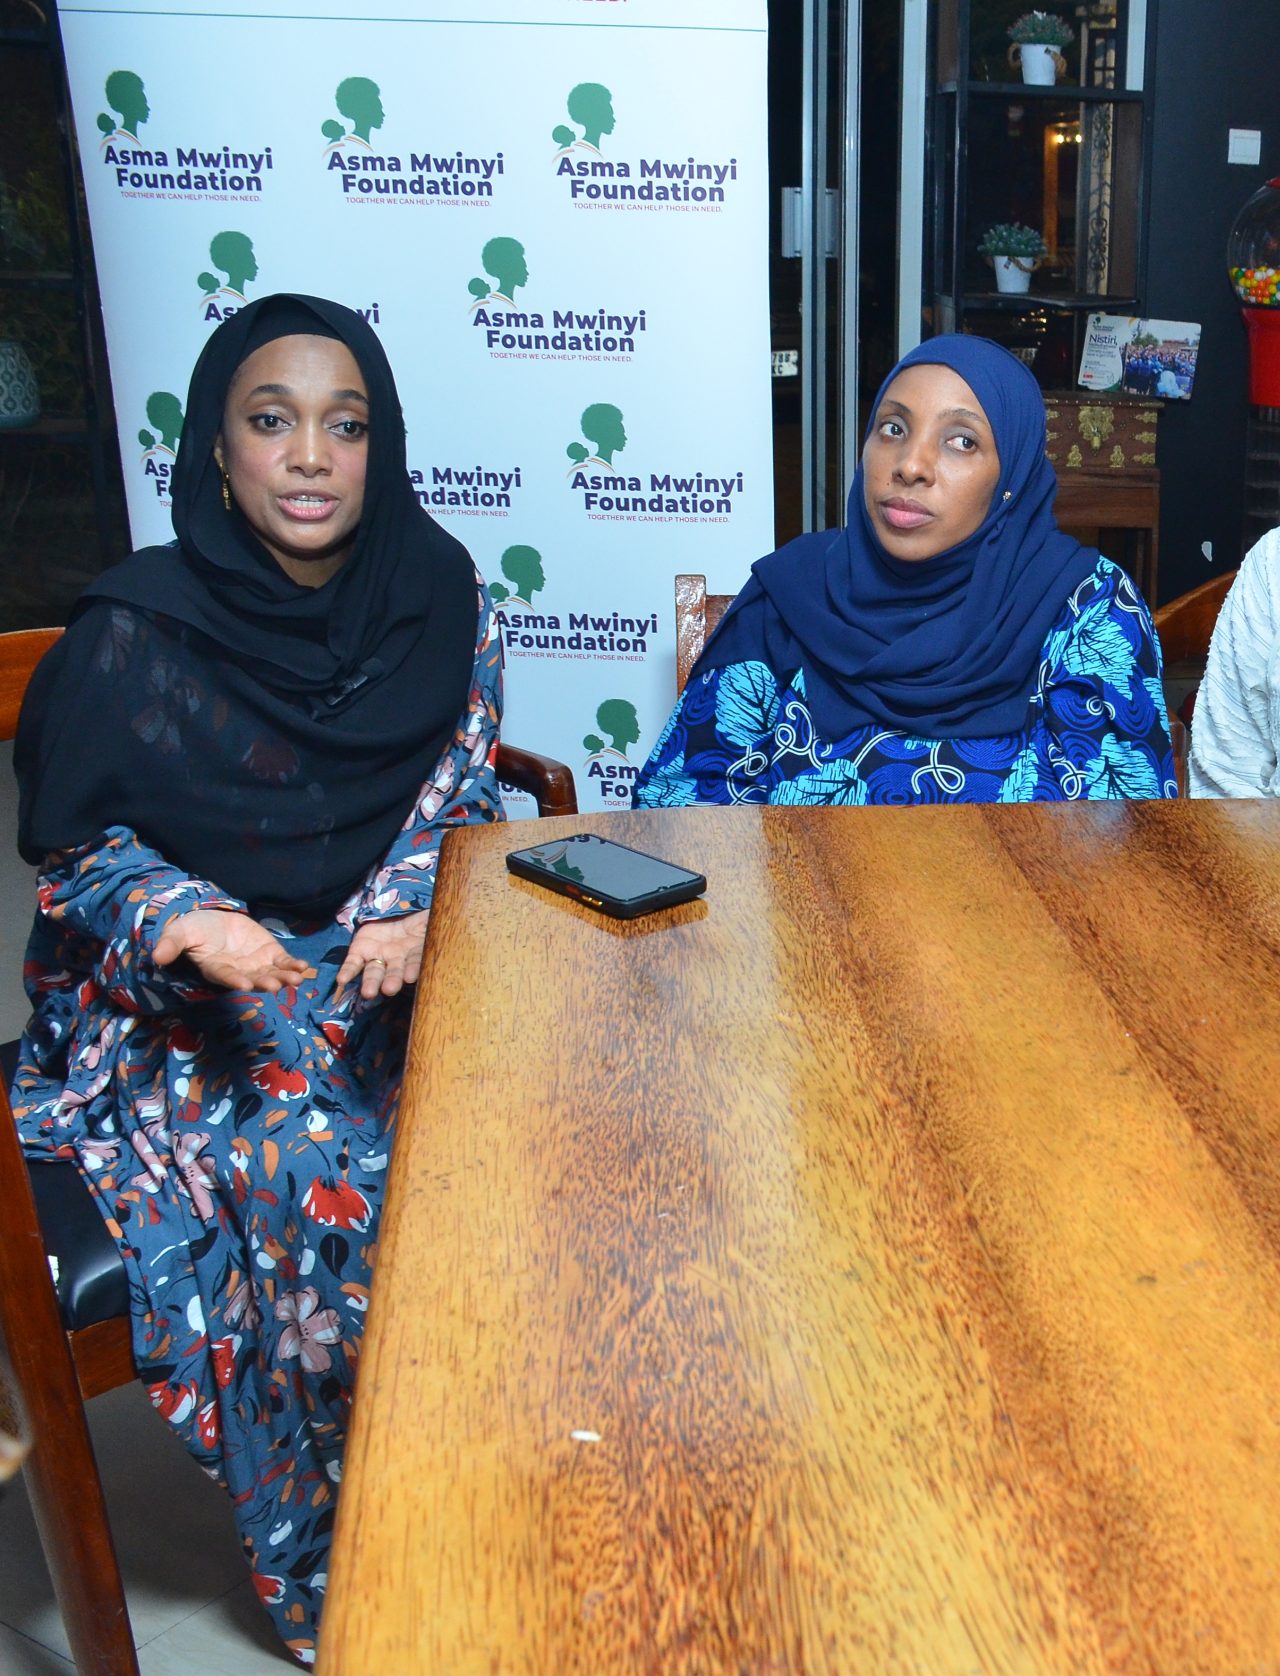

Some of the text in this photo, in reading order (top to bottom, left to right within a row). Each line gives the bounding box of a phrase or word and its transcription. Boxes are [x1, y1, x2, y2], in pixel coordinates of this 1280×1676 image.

[104, 145, 273, 174] Asma Mwinyi
[327, 151, 504, 179] Asma Mwinyi
[116, 168, 262, 191] Foundation
[556, 157, 737, 185] Asma Mwinyi
[342, 174, 493, 196] Foundation
[571, 179, 725, 202] Foundation
[121, 191, 155, 199] TOGETHER
[156, 192, 166, 200] WE
[168, 192, 183, 200] CAN
[184, 193, 203, 201] HELP
[230, 194, 238, 202] IN
[239, 194, 262, 202] NEED.
[346, 197, 385, 205] TOGETHER
[399, 198, 415, 206] CAN
[416, 198, 434, 206] HELP
[574, 202, 613, 210] TOGETHER
[614, 203, 625, 211] WE
[700, 205, 723, 213] NEED.
[473, 308, 646, 336] Asma Mwinyi
[486, 330, 635, 352] Foundation
[145, 458, 170, 477] As
[432, 466, 522, 492] Mwinyi
[571, 472, 743, 498] Asma Mwinyi
[414, 486, 511, 507] ndation
[585, 492, 732, 513] Foundation
[498, 610, 657, 638] Asma Mwinyi
[506, 630, 647, 652] Foundation
[587, 761, 640, 780] Asm
